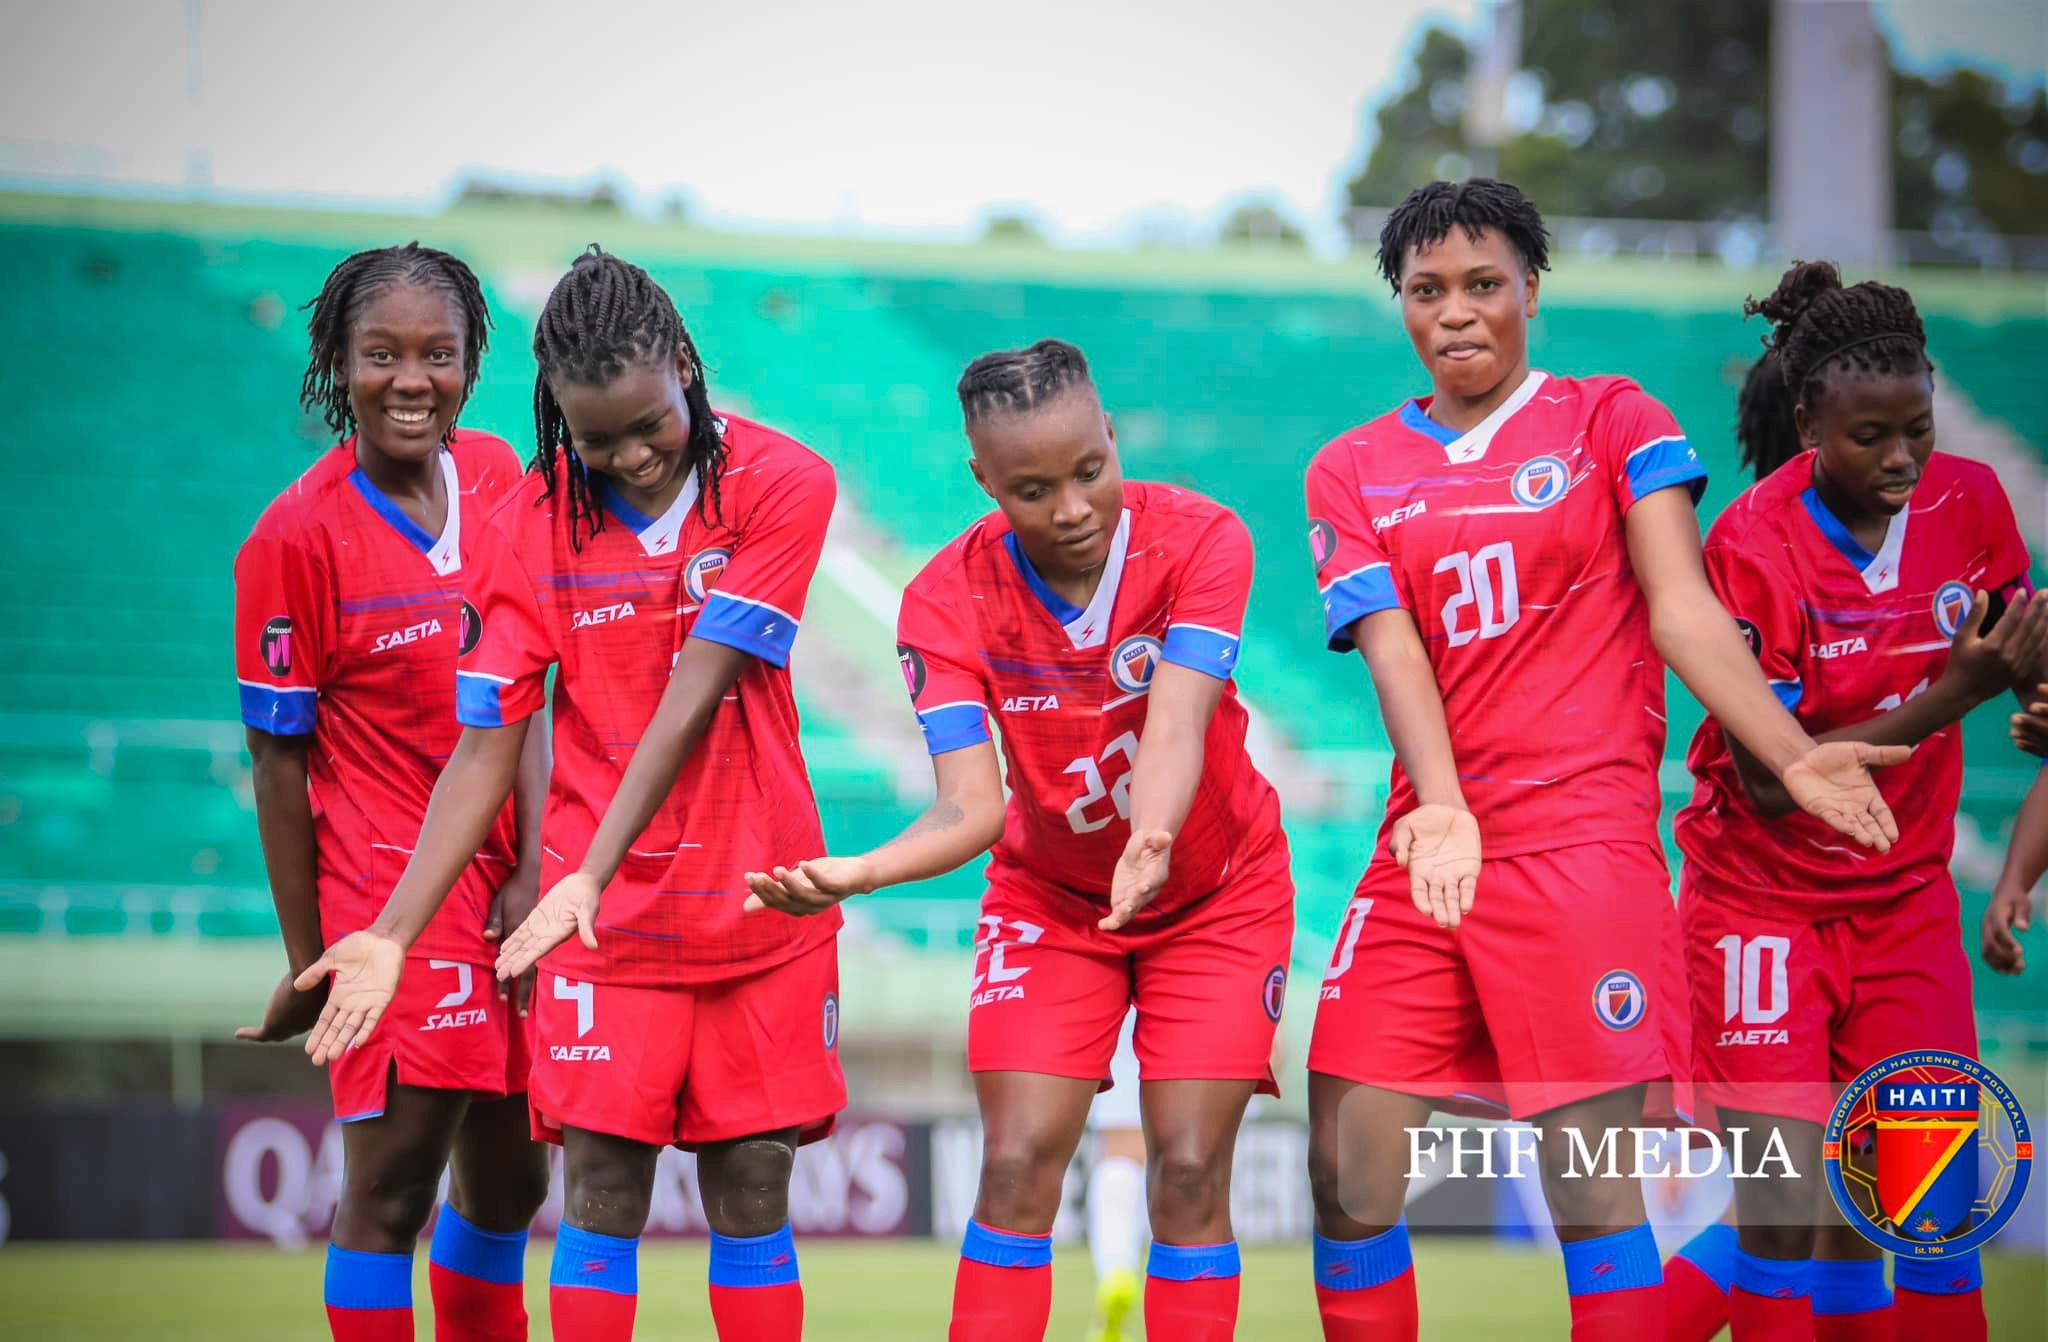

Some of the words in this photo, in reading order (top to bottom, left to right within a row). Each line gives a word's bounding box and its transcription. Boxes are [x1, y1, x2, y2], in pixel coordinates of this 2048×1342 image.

[1432, 541, 1519, 648] 20
[571, 601, 636, 632] SAETA
[370, 618, 442, 654] SAETA
[1809, 637, 1868, 659] SAETA
[1000, 695, 1059, 712] AETA
[1062, 730, 1139, 834] 22
[972, 915, 1045, 993] 22
[1713, 934, 1791, 1024] 10
[419, 1008, 488, 1031] SAETA
[554, 975, 594, 1039] 4
[1715, 1029, 1789, 1046] SAETA
